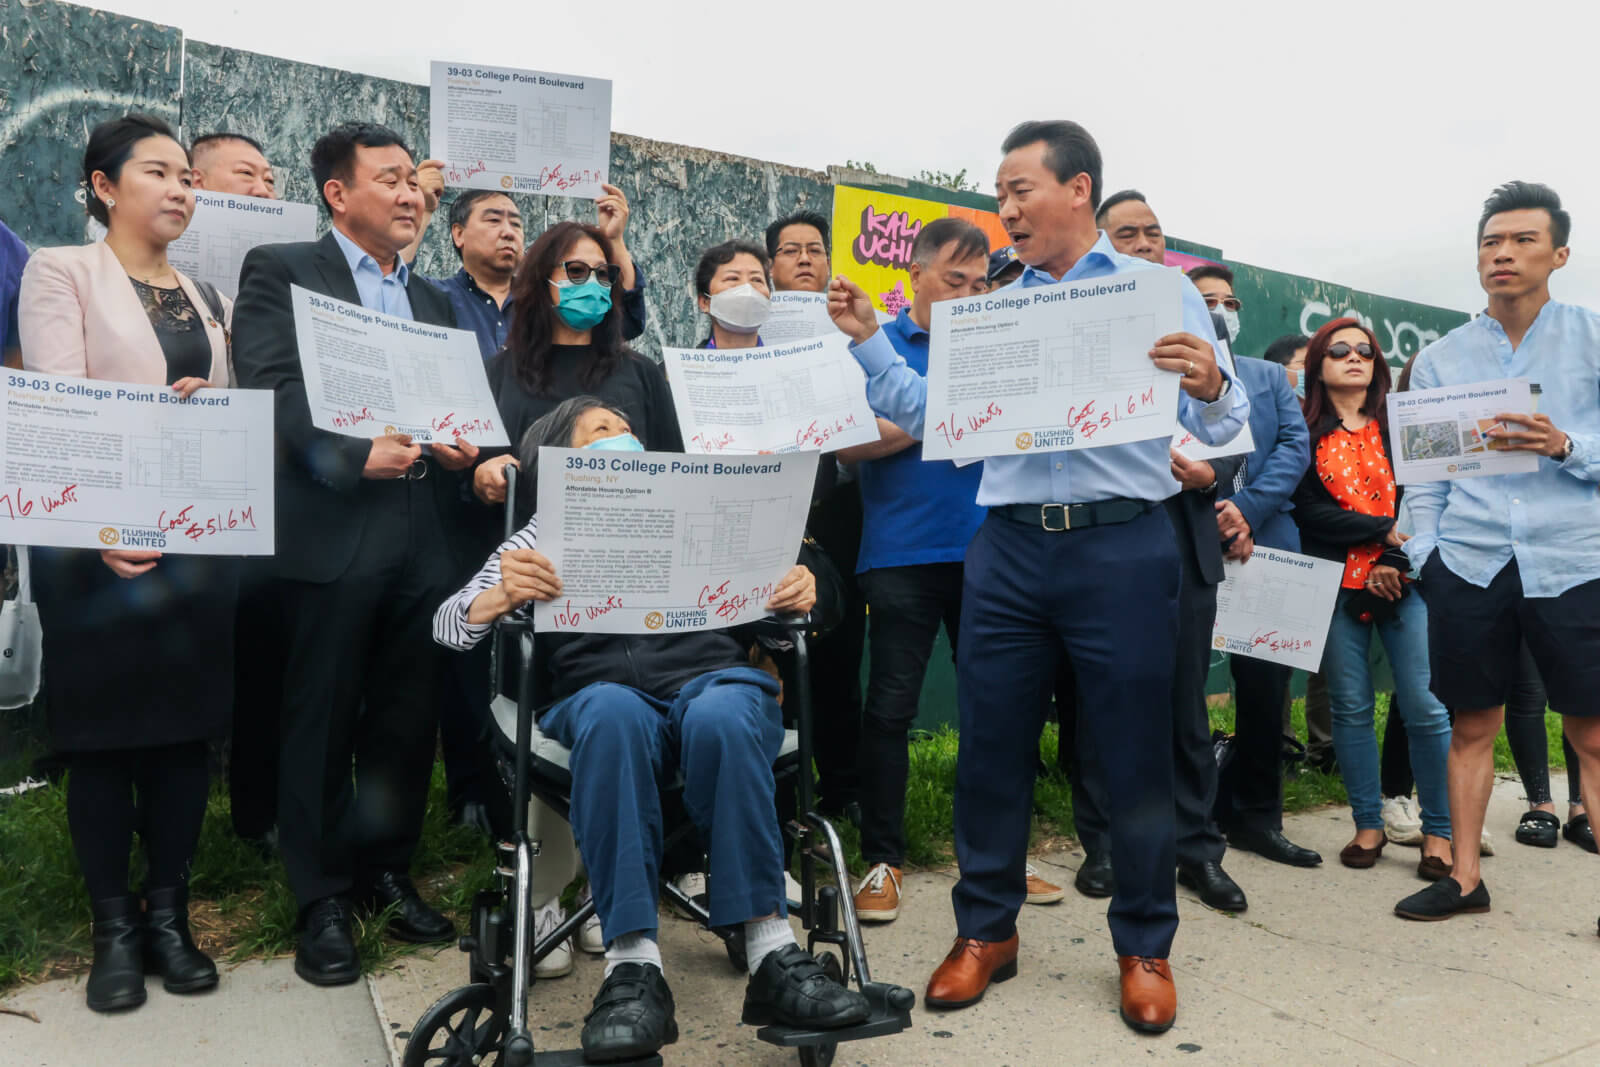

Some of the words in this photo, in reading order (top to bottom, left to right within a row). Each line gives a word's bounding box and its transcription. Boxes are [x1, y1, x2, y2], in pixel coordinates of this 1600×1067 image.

[447, 67, 473, 78] 39-03
[475, 70, 510, 82] College
[513, 74, 537, 85] Point
[539, 77, 584, 90] Boulevard
[514, 182, 541, 191] UNITED
[195, 195, 224, 209] Point
[228, 200, 283, 215] Boulevard
[855, 233, 913, 268] UCHI
[782, 295, 812, 304] College
[951, 303, 982, 316] 39-03
[985, 297, 1030, 312] College
[1034, 289, 1067, 305] Point
[1070, 280, 1136, 299] Boulevard
[308, 296, 335, 312] 39-03
[337, 306, 374, 324] College
[375, 316, 400, 330] Point
[401, 323, 448, 340] Boulevard
[680, 353, 705, 362] 39-03
[707, 354, 743, 364] College
[746, 351, 772, 361] Point
[774, 341, 823, 357] Boulevard
[8, 376, 50, 391] 39-03
[55, 382, 112, 400] College
[116, 389, 154, 403] Point
[159, 392, 230, 407] Boulevard
[1142, 386, 1154, 405] M
[1418, 396, 1445, 405] College
[1447, 393, 1466, 401] Point
[1468, 388, 1507, 399] Boulevard
[411, 433, 432, 441] ITED
[936, 413, 964, 448] 76
[1034, 429, 1074, 439] FLUSHING
[1034, 436, 1074, 448] UNITED
[566, 456, 606, 471] 39-03
[611, 459, 666, 476] College
[671, 461, 709, 475] Point
[713, 461, 782, 476] Boulevard
[606, 475, 620, 483] NY
[598, 486, 624, 495] Housing
[625, 487, 646, 495] Option
[242, 506, 256, 528] M
[122, 528, 166, 539] FLUSHING
[122, 537, 167, 548] UNITED
[1250, 551, 1266, 560] oint
[1268, 553, 1314, 569] Boulevard
[553, 599, 580, 629] 106
[665, 617, 707, 628] UNITED
[666, 609, 707, 620] FLUSHING
